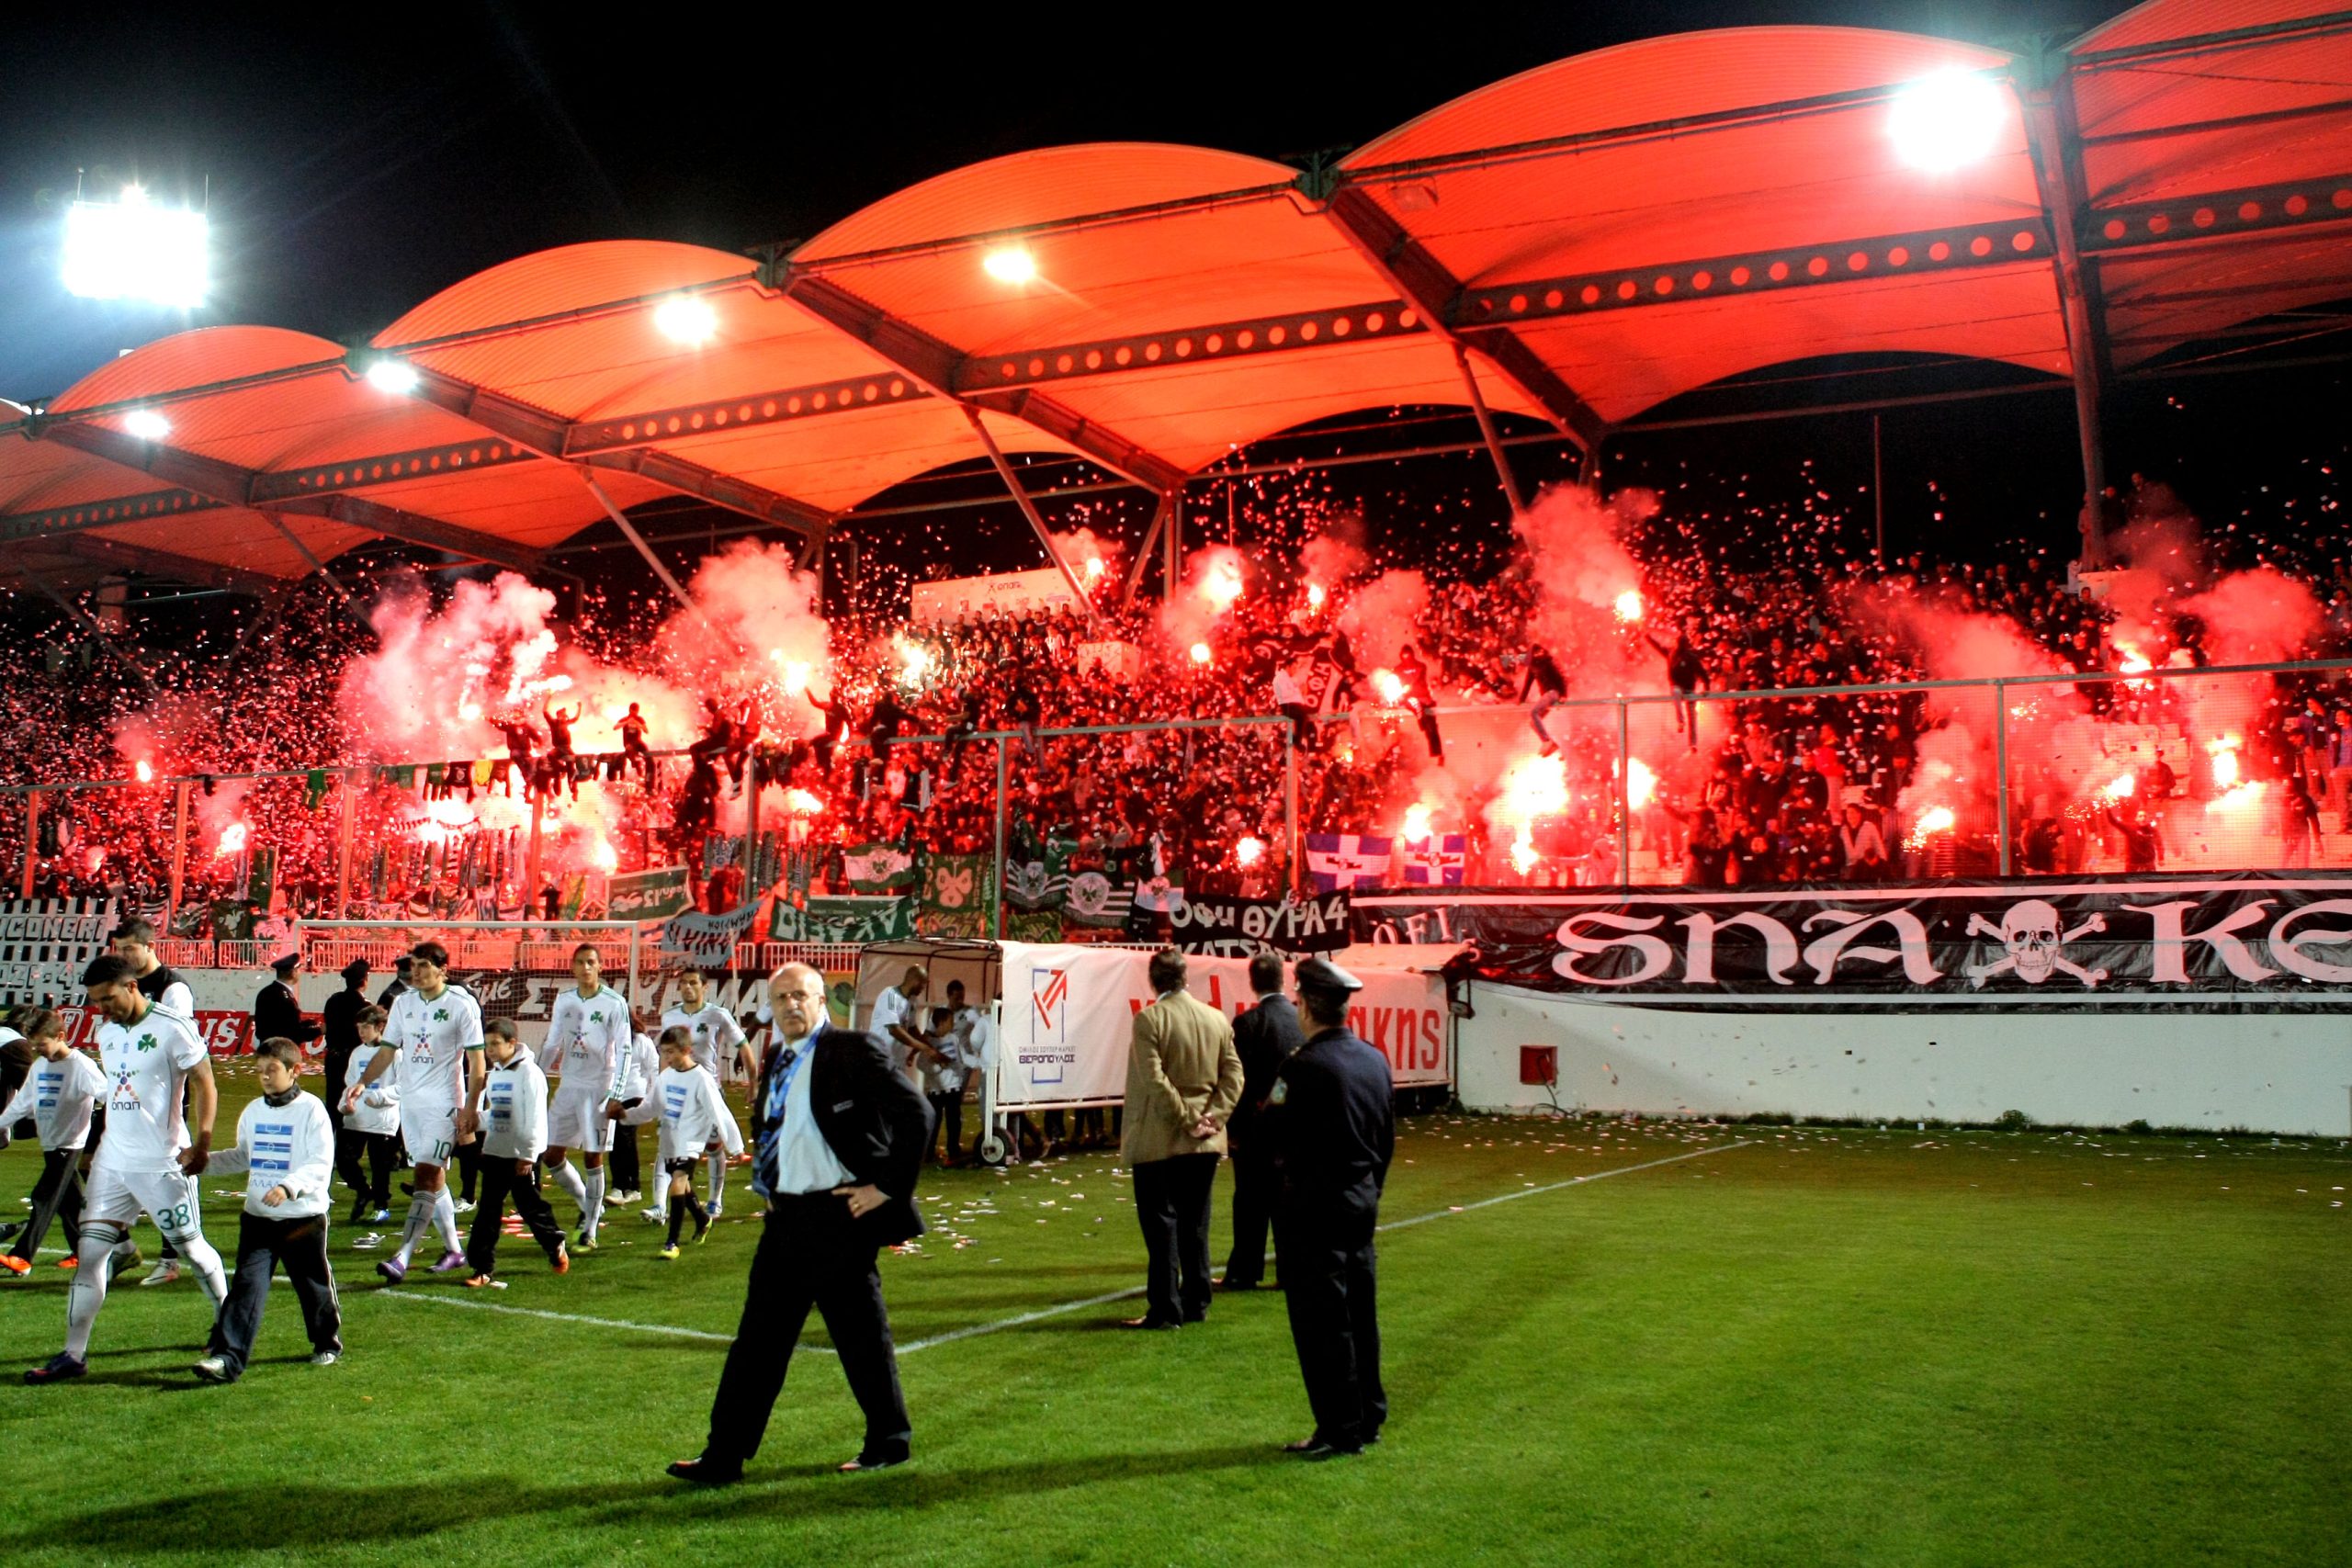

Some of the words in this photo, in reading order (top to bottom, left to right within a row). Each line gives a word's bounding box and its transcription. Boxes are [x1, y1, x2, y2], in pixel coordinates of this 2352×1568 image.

[1018, 1054, 1076, 1064] ΒΕΡΟΠΟΥΛΟΣ
[432, 1138, 453, 1162] 10
[157, 1203, 191, 1231] 38
